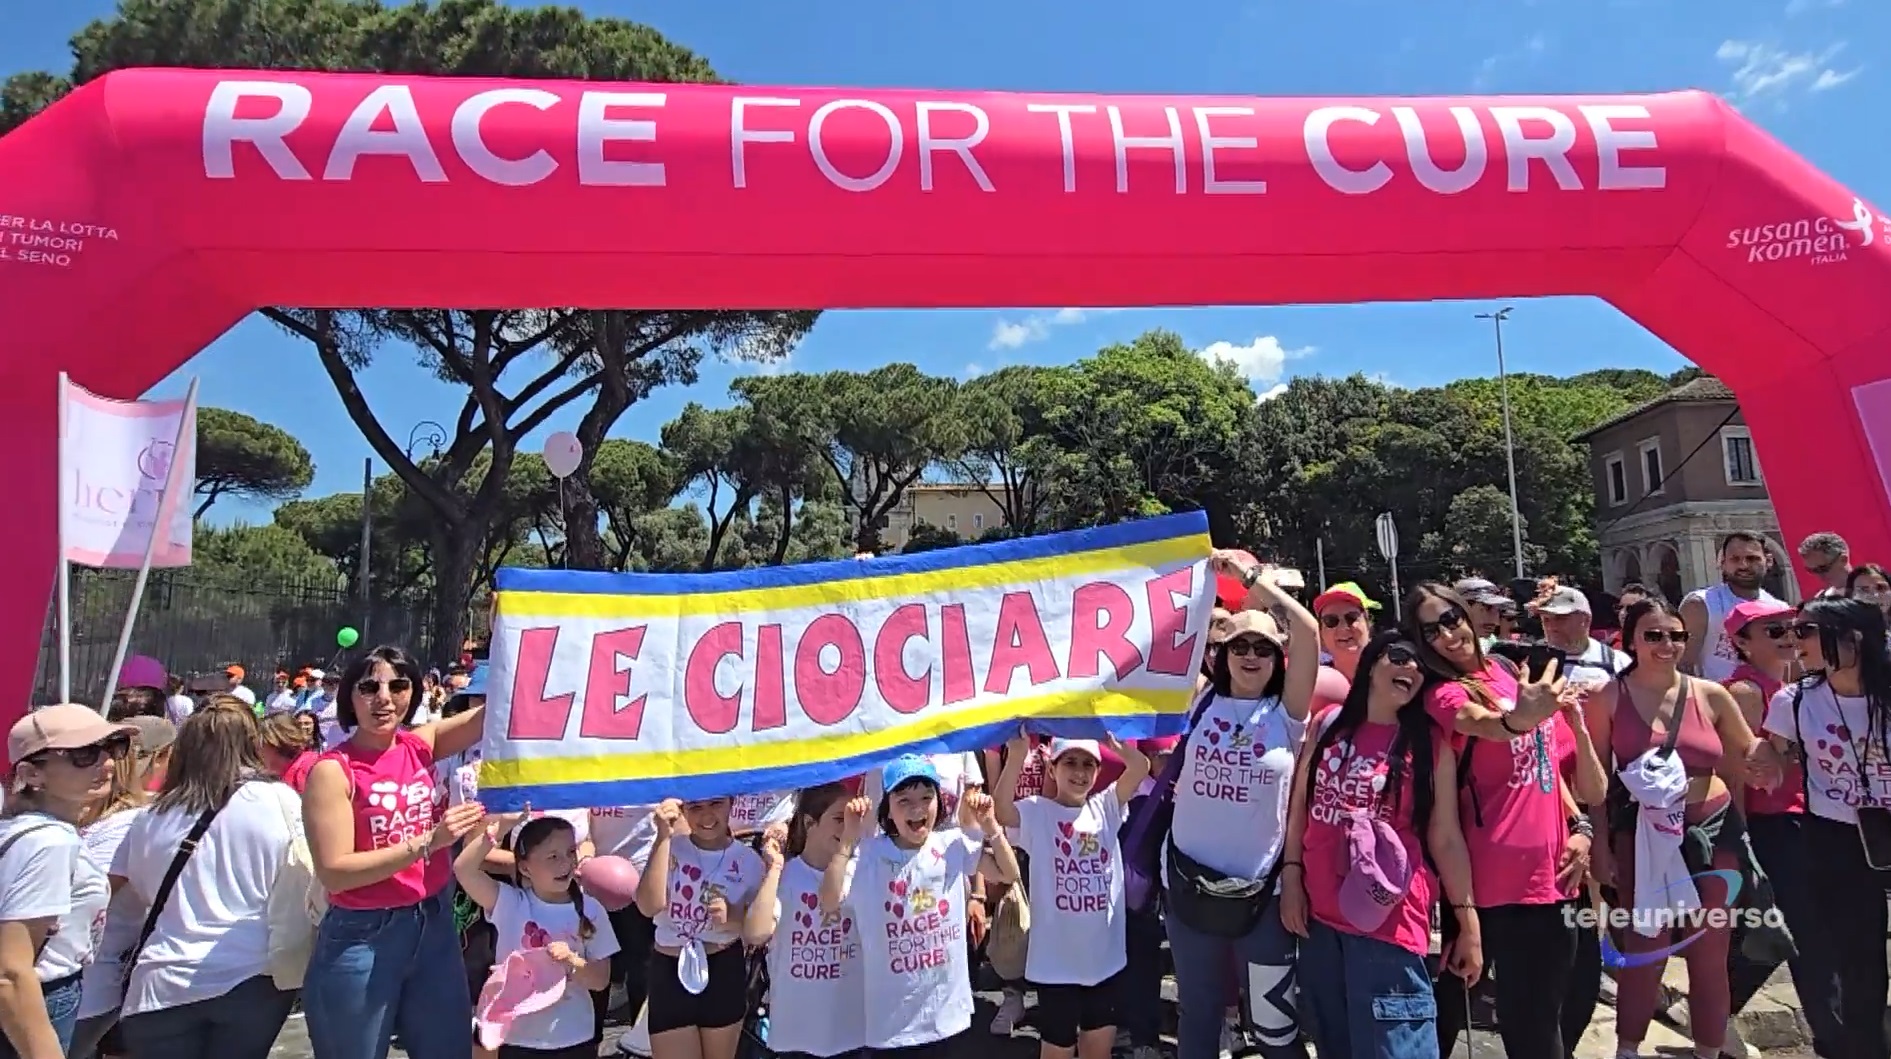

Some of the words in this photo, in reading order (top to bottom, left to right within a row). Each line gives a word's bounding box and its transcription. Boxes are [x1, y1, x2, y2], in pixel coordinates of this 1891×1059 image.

[202, 80, 667, 187] RACE
[731, 96, 997, 192] FOR
[1027, 103, 1267, 194] THE
[1303, 105, 1667, 194] CURE
[0, 215, 25, 228] ER
[29, 219, 54, 231] LA
[60, 221, 118, 240] LOTTA
[11, 232, 83, 251] TUMORI
[17, 249, 71, 267] SENO
[1811, 252, 1847, 265] ITALIA
[507, 623, 648, 741] LE
[684, 566, 1198, 734] CIOCIARE
[1195, 745, 1251, 766] RACE
[1195, 761, 1232, 782] FOR
[1238, 768, 1275, 785] THE
[1315, 767, 1370, 799] RACE
[1015, 786, 1041, 798] URE
[1193, 780, 1249, 803] CURE
[370, 800, 433, 834] RACE
[591, 806, 624, 819] URE
[731, 808, 756, 821] URE
[373, 825, 416, 850] FOR
[1054, 857, 1101, 875] RACE
[1056, 875, 1091, 894] FOR
[1055, 893, 1107, 912] CURE
[886, 912, 940, 938] RACE
[792, 929, 842, 946] RACE
[888, 935, 926, 956] FOR
[931, 924, 961, 946] THE
[791, 946, 826, 962] FOR
[829, 943, 857, 961] THE
[891, 949, 946, 974] CURE
[791, 964, 841, 980] CURE
